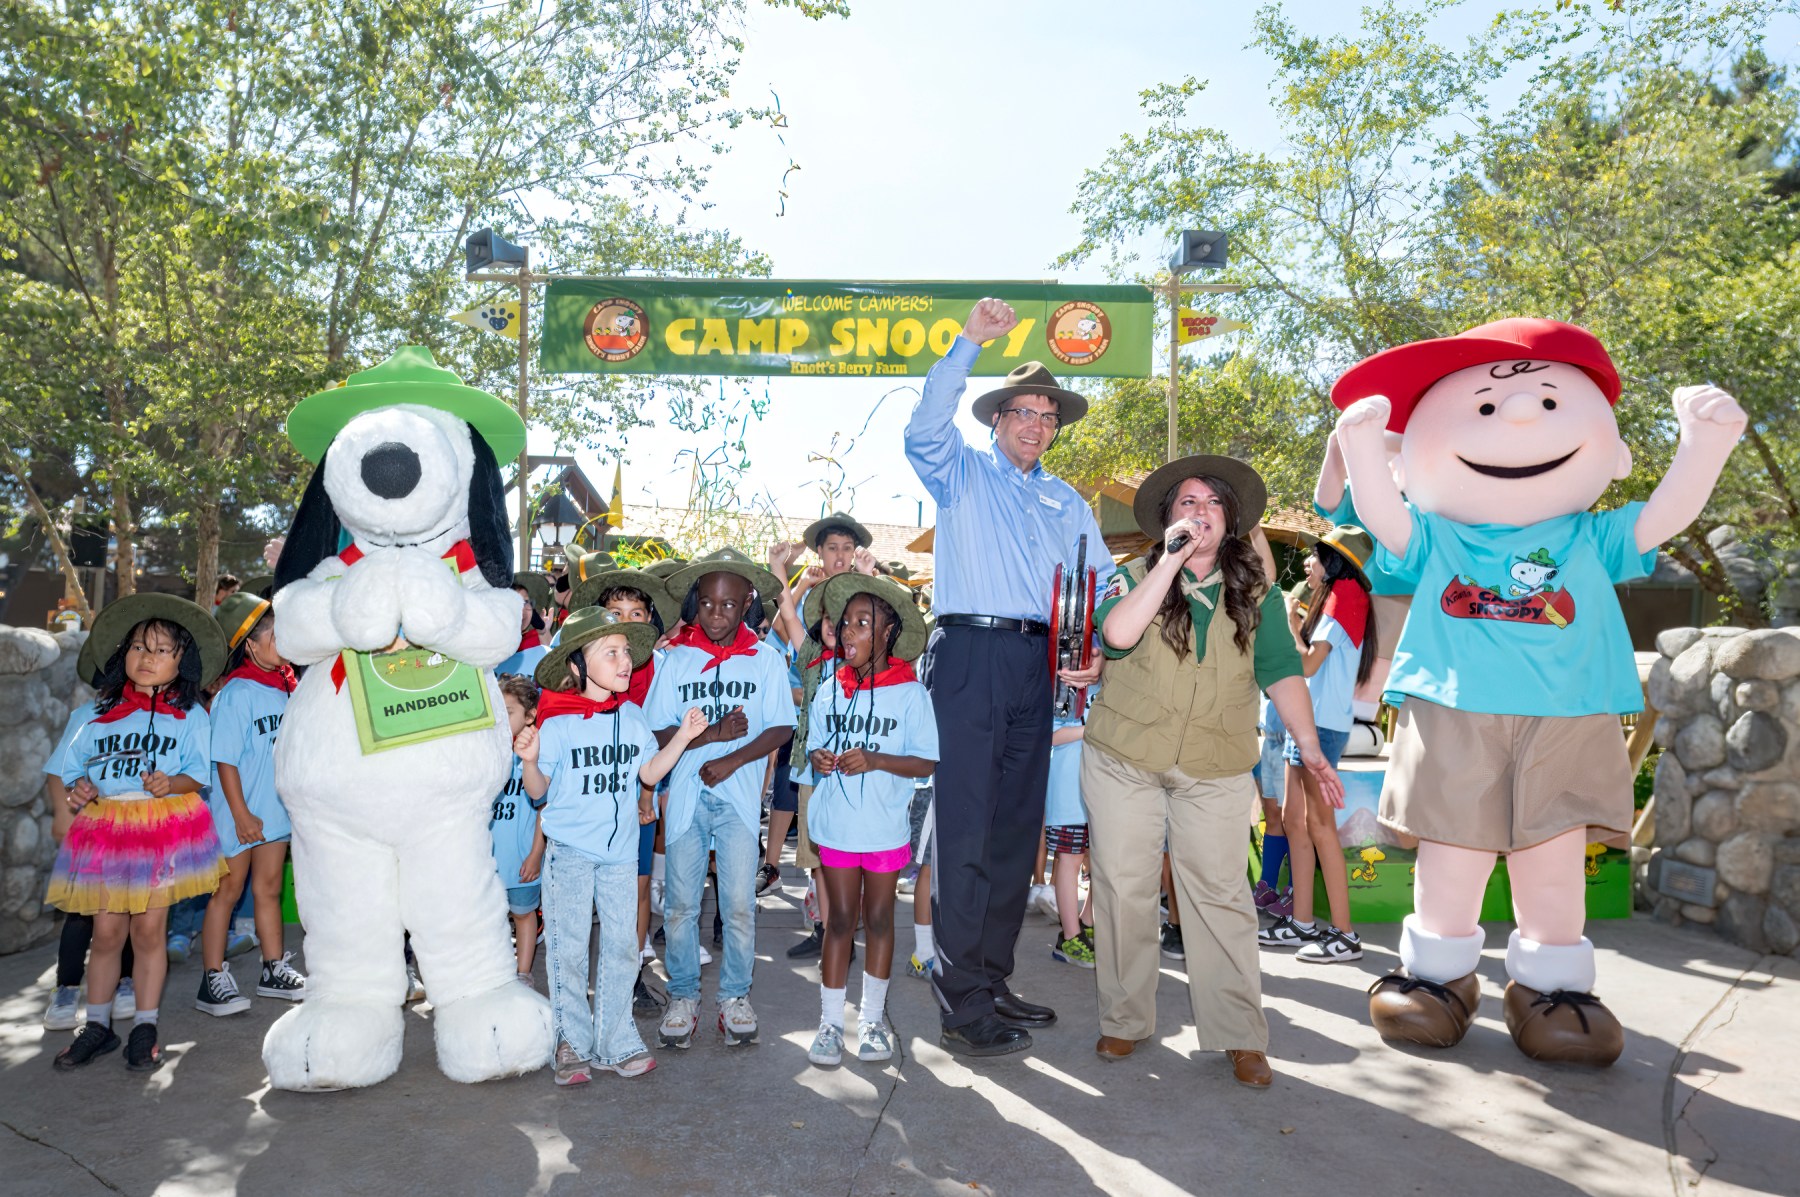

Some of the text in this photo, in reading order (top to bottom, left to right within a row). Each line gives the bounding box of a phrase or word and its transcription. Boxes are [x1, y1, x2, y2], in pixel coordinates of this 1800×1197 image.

[782, 295, 933, 312] WELCOME CAMPERS!
[665, 317, 1036, 357] CAMP SNOOY
[790, 361, 908, 376] Knott's Berry Farm
[383, 689, 470, 717] HANDBOOK
[678, 681, 757, 703] TROOP
[825, 713, 898, 737] TROOP
[94, 732, 177, 757] TROOP
[571, 743, 640, 769] TROOP
